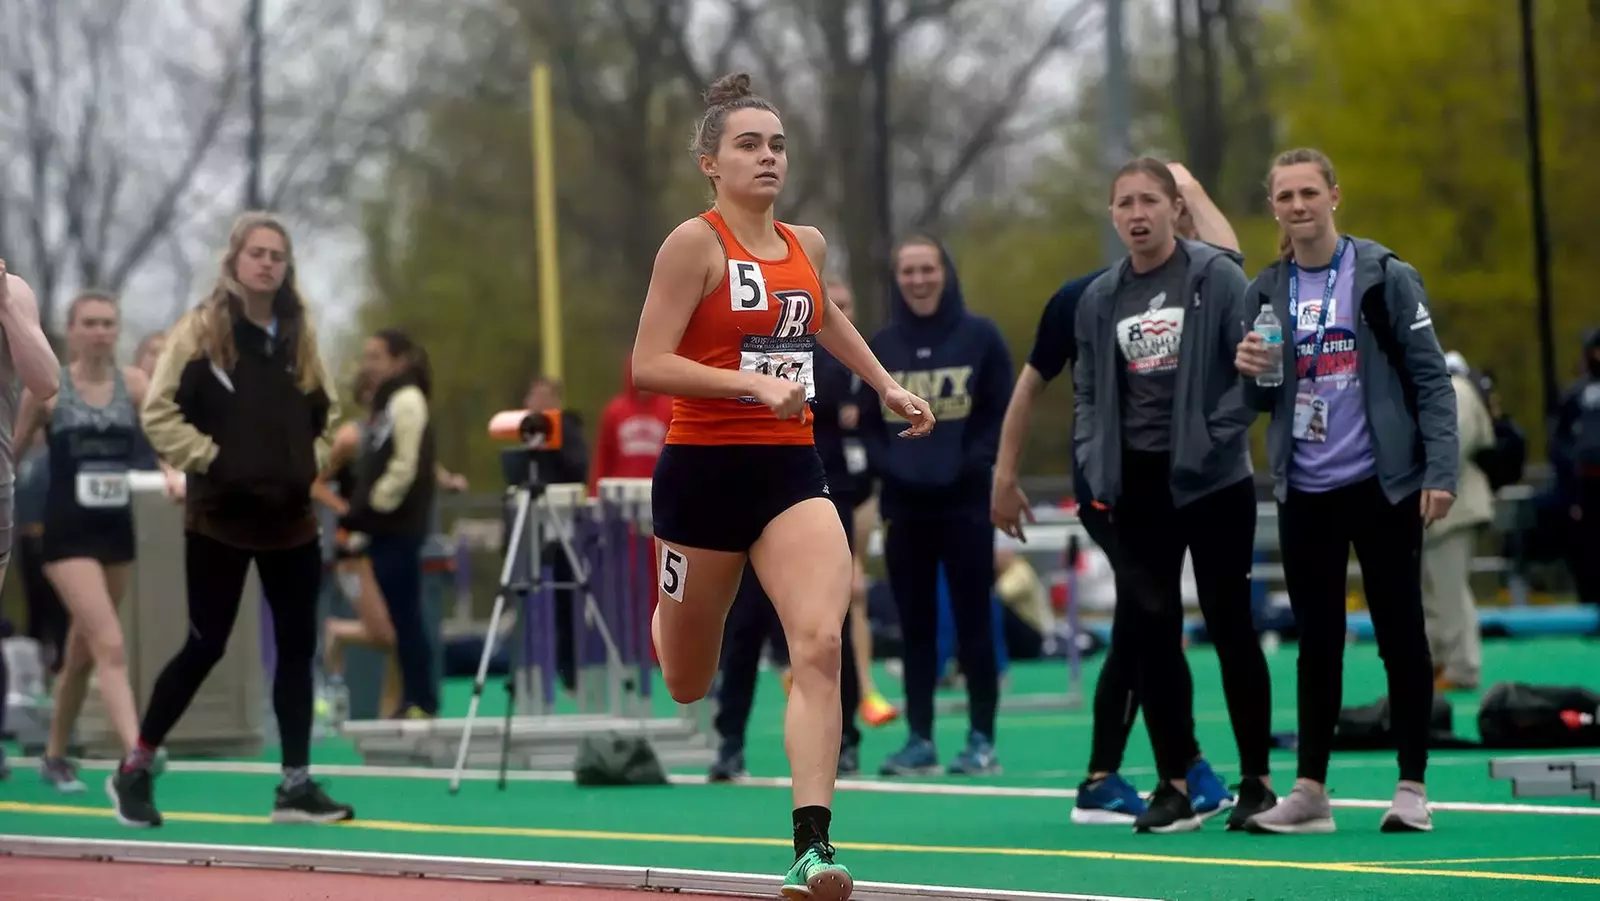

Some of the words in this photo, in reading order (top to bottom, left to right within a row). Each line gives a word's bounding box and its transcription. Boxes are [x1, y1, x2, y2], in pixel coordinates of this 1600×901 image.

[737, 263, 760, 309] 5
[1323, 342, 1330, 353] &
[1330, 339, 1355, 353] FIELD
[663, 549, 682, 595] 5
